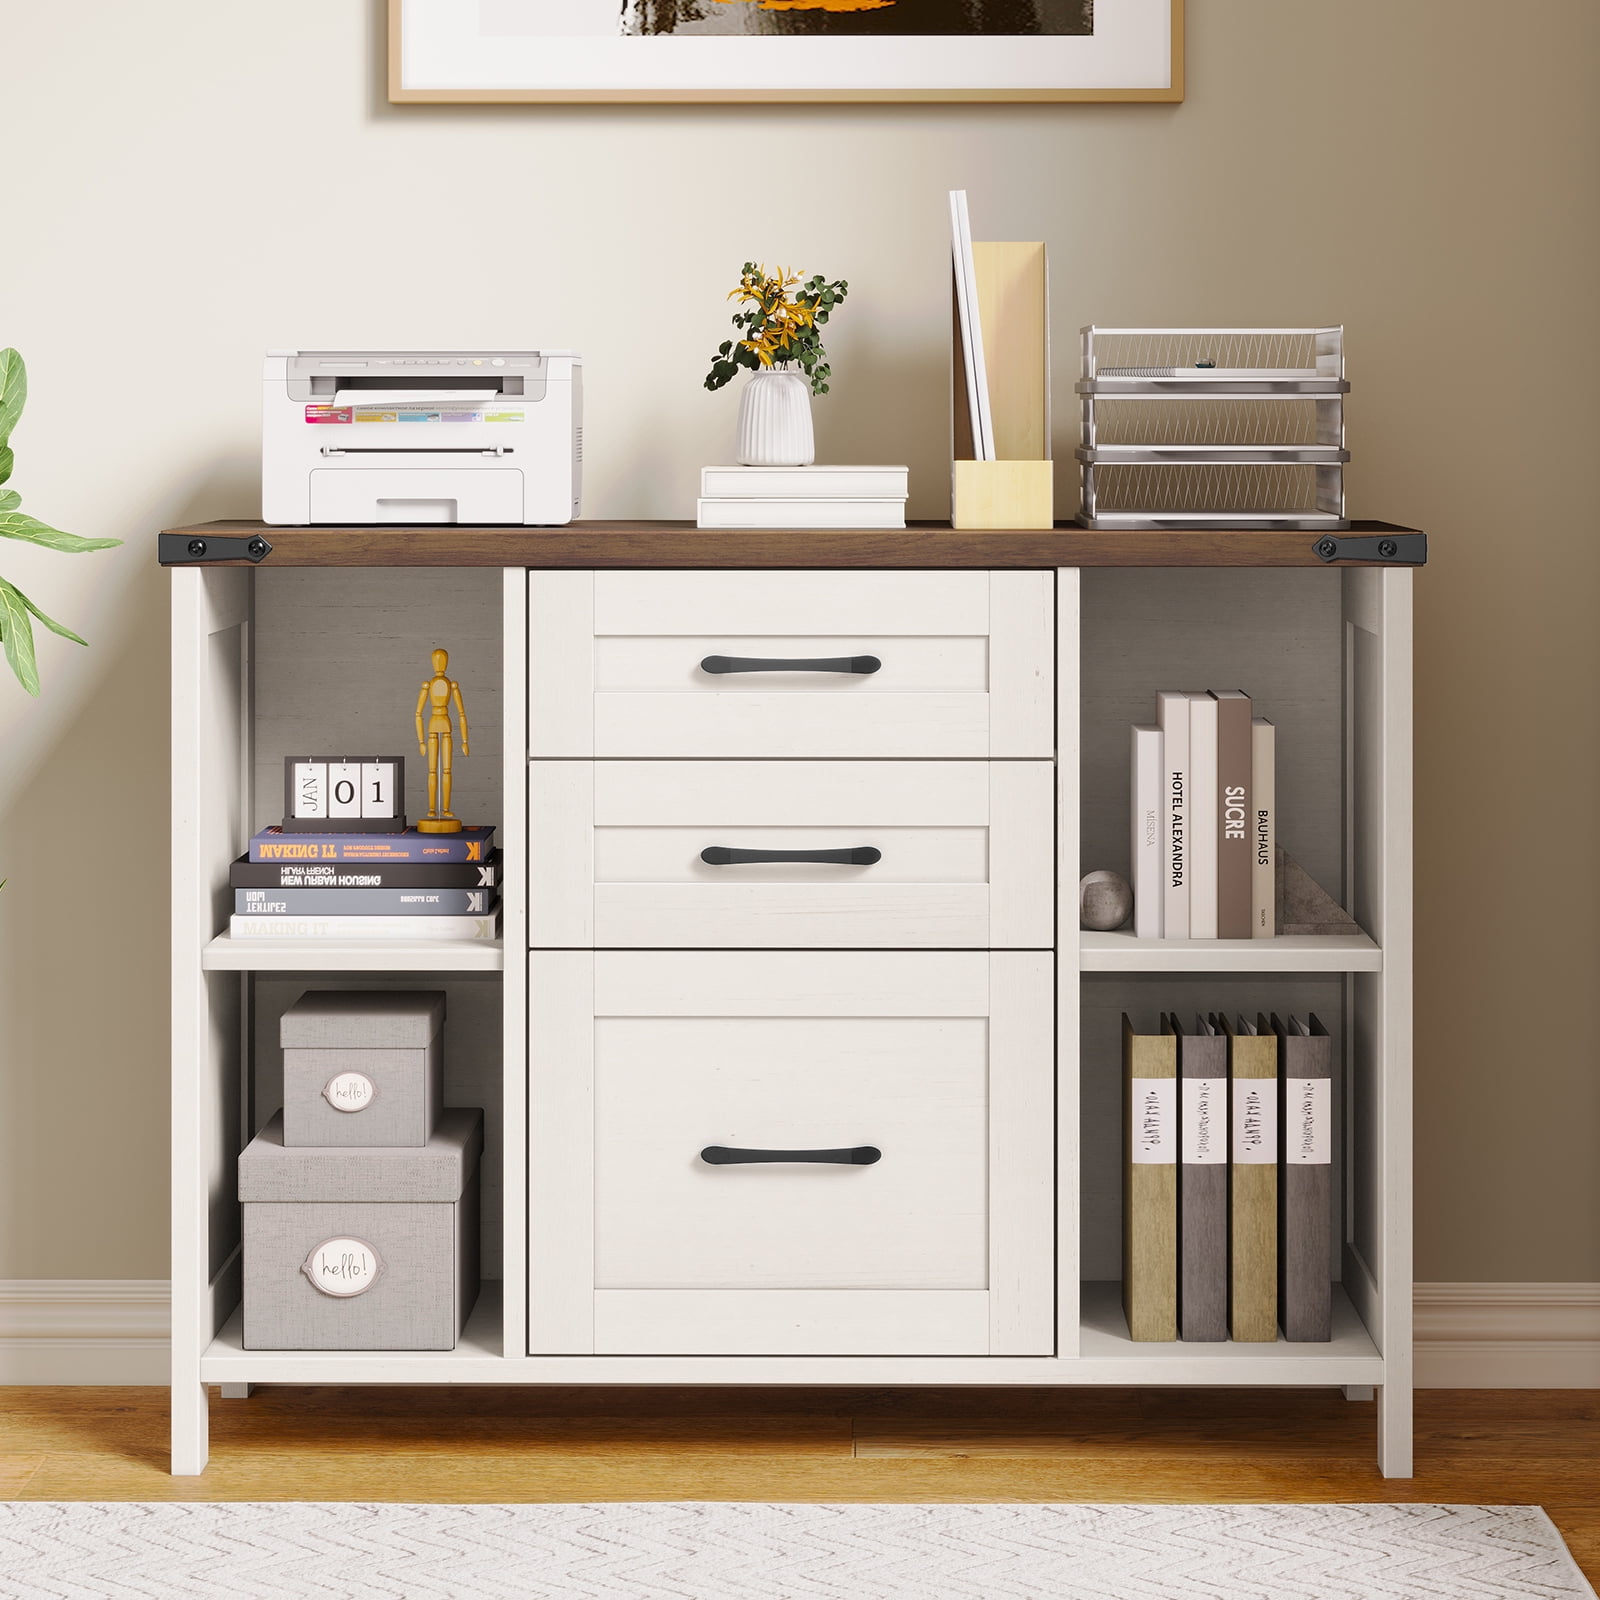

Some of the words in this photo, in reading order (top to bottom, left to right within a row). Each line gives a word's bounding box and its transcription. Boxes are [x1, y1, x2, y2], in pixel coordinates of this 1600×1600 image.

[302, 777, 318, 811] JAN
[1172, 771, 1183, 811] HOTEL
[1224, 786, 1246, 839] SUCRE
[1172, 813, 1183, 888] ALEXANDRA
[1257, 810, 1269, 865] BAUHAUS
[243, 922, 308, 936] MAKING
[312, 922, 329, 936] IT
[335, 1082, 368, 1100] hello!
[321, 1252, 368, 1281] hello!
